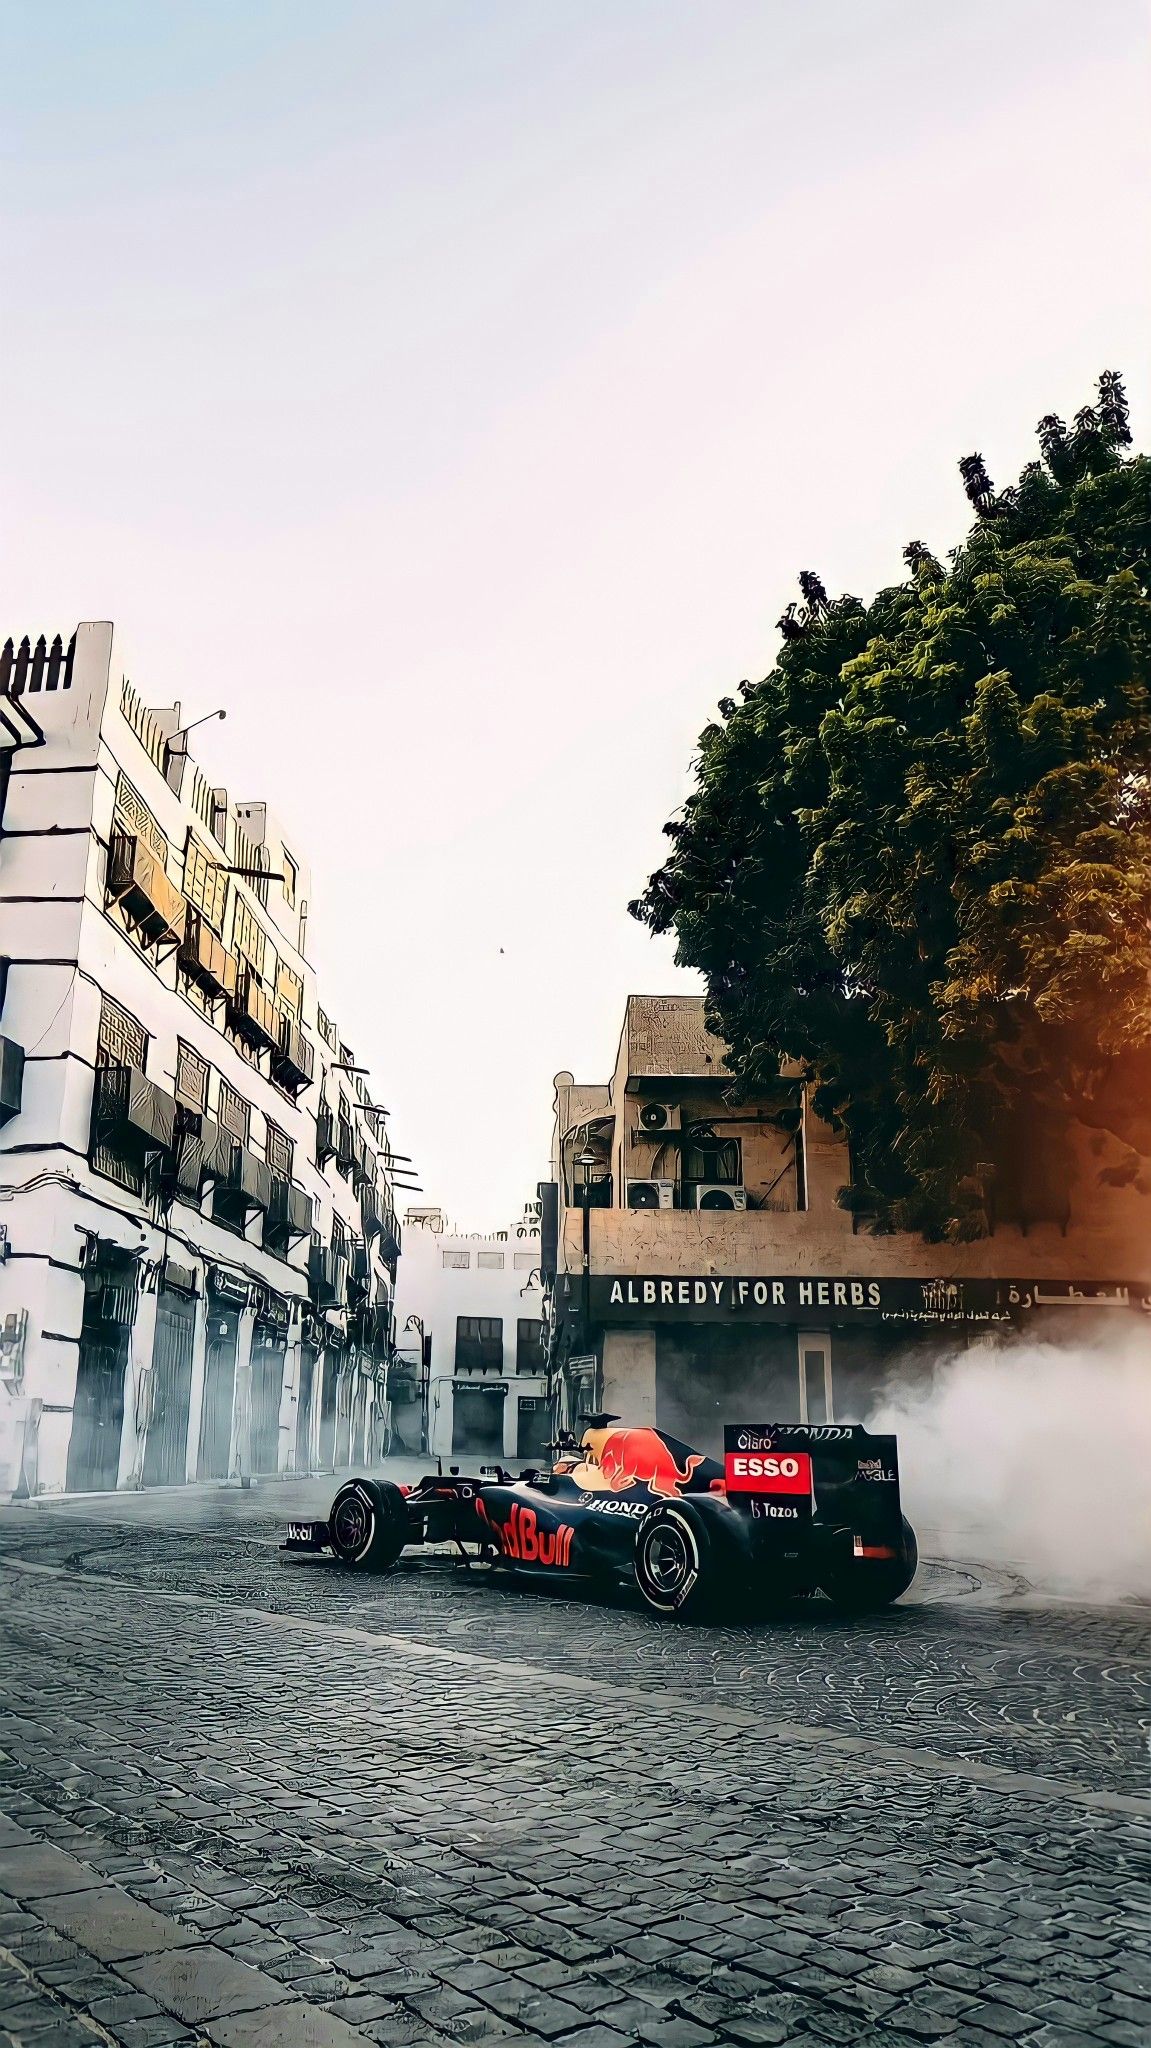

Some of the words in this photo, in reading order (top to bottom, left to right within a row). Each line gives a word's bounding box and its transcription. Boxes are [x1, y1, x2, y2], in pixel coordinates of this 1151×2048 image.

[610, 1280, 724, 1305] ALBREDY
[738, 1281, 786, 1305] FOR
[799, 1281, 880, 1306] HERBS
[737, 1433, 772, 1450] Claro
[733, 1458, 799, 1478] ESSO
[585, 1499, 649, 1520] HOND
